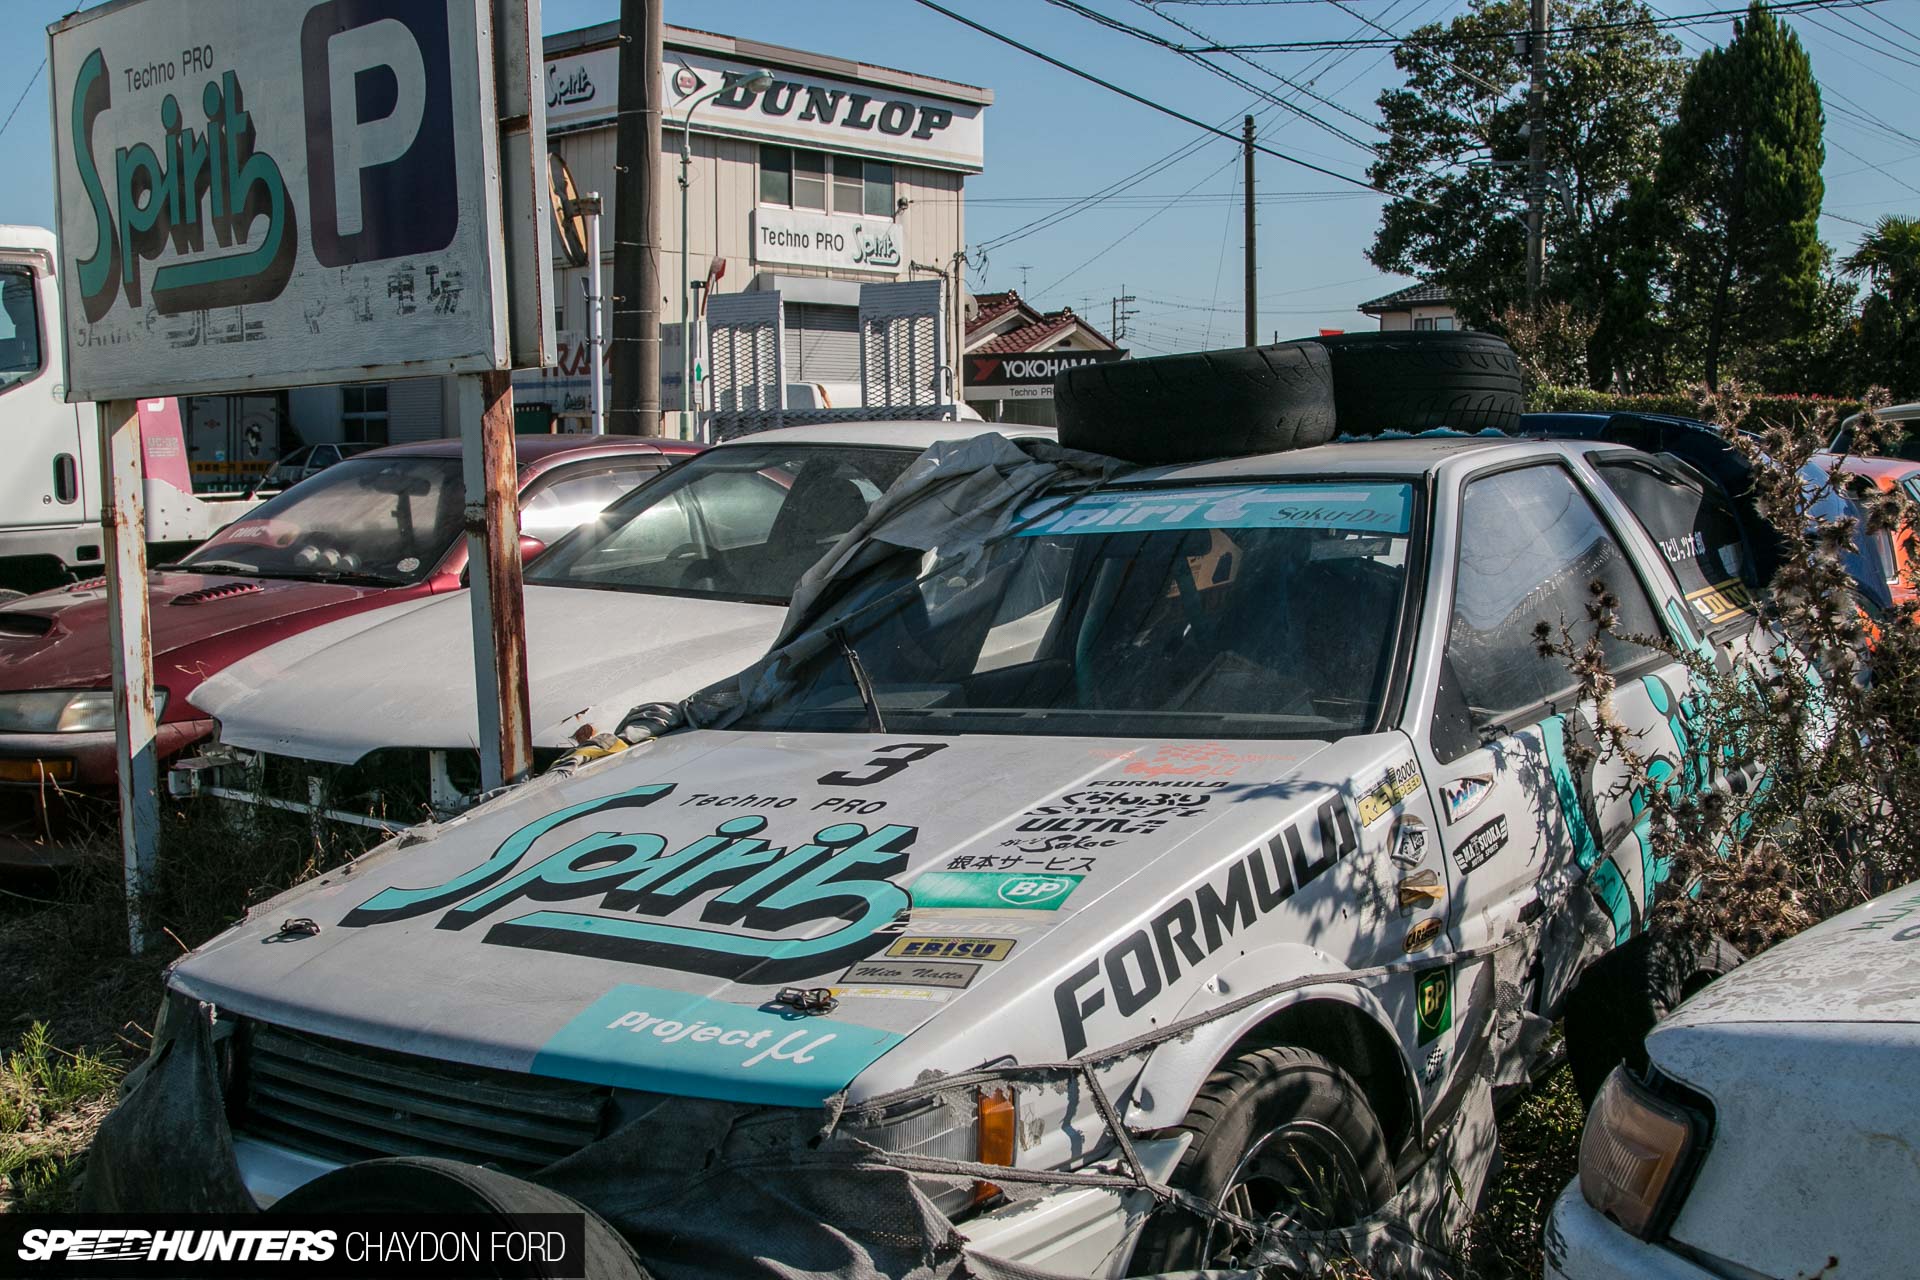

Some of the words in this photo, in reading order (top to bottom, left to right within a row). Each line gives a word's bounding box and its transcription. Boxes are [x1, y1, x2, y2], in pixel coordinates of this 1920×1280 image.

[125, 61, 175, 94] Techno
[182, 43, 214, 74] PRO
[712, 69, 954, 141] DUNLOP
[328, 18, 427, 237] P
[72, 47, 298, 324] Spirit
[760, 226, 810, 249] Techno
[816, 232, 845, 252] PRO
[851, 222, 901, 268] Spirit
[1010, 388, 1038, 397] Techno
[1041, 387, 1055, 396] PR
[817, 742, 949, 787] 3
[1395, 758, 1417, 785] 2000
[1086, 780, 1230, 788] FORMULA
[1393, 773, 1422, 801] SPEED
[679, 793, 799, 809] Techno
[811, 797, 888, 815] PRO
[946, 855, 1098, 873] 根本サービス
[337, 783, 918, 984] Spirit
[1005, 880, 1061, 899] BP
[1053, 797, 1357, 1060] FORMULA
[900, 942, 998, 958] EBISU
[855, 967, 903, 977] Mito
[911, 968, 964, 980] Natto
[1424, 979, 1445, 1016] BP
[607, 1009, 773, 1050] project
